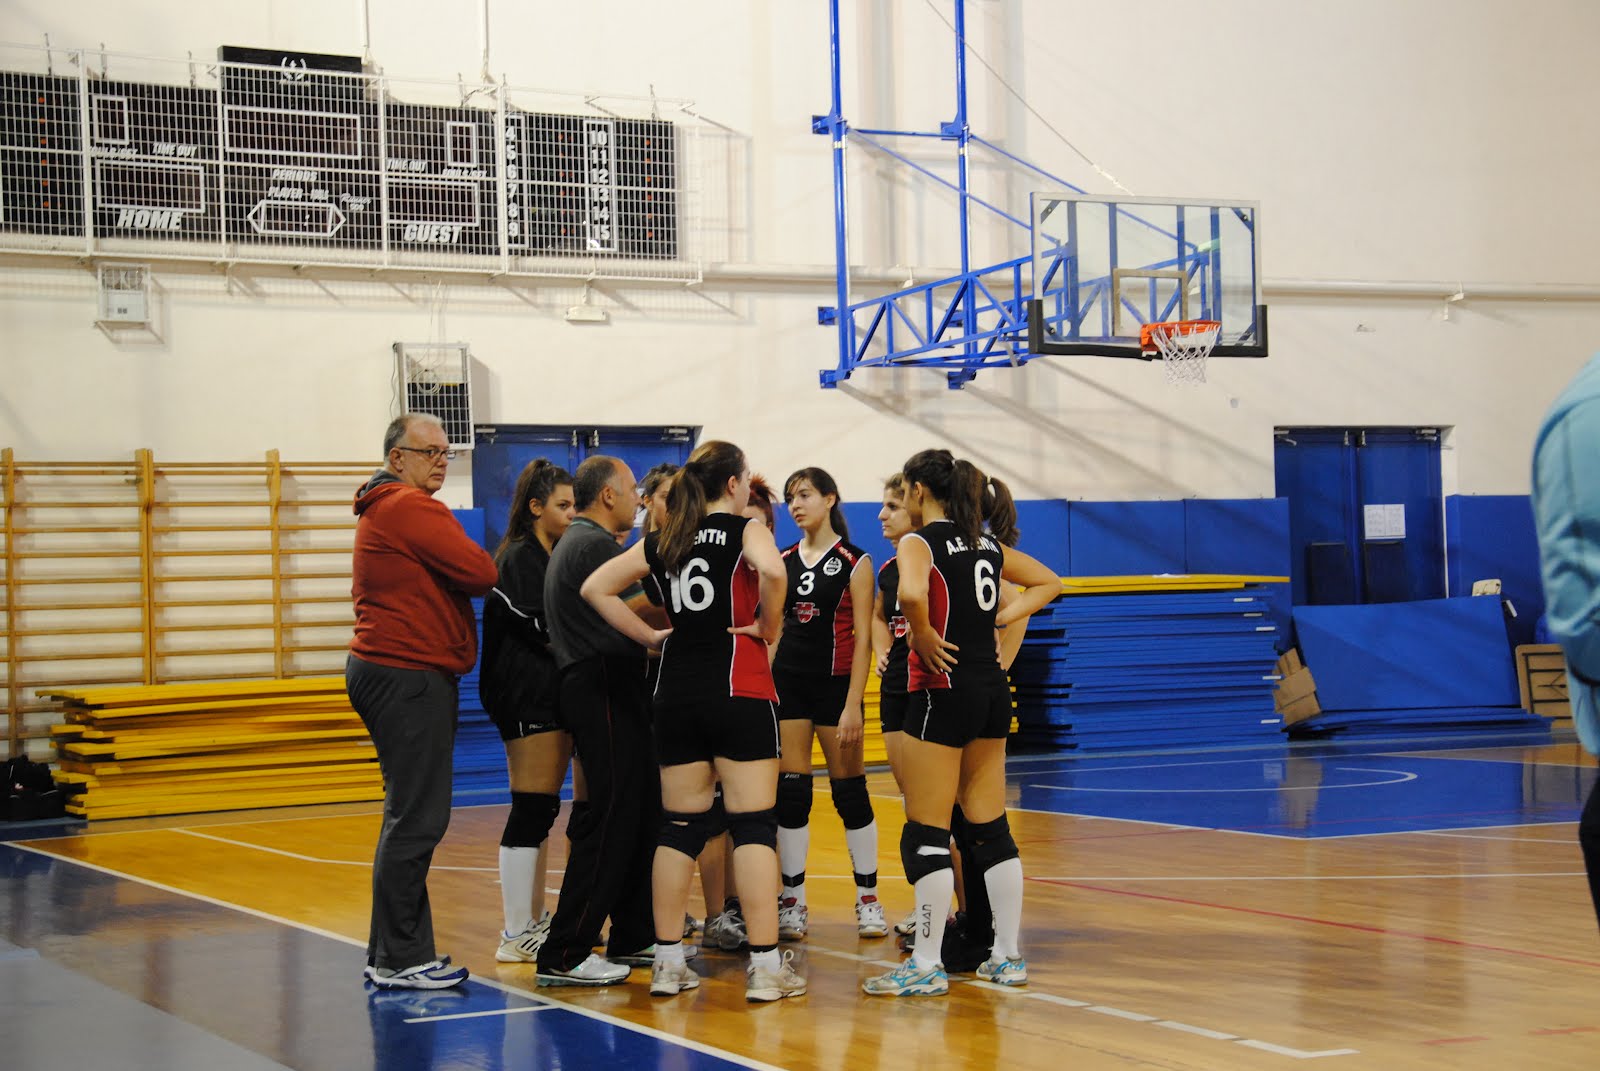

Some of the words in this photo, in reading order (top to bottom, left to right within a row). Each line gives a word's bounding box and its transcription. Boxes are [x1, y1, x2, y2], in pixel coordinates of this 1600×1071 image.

[506, 126, 516, 141] 4
[591, 130, 608, 146] 10
[152, 142, 176, 156] TIME
[177, 145, 198, 158] OUT
[507, 145, 516, 160] 5
[591, 149, 608, 165] 11
[273, 169, 318, 181] PERIODS
[507, 164, 517, 179] 6
[591, 168, 609, 184] 12
[267, 186, 304, 199] PLAYER
[508, 183, 518, 199] 7
[592, 187, 609, 202] 13
[508, 202, 518, 218] 8
[592, 206, 610, 221] 14
[117, 208, 184, 230] HOME
[403, 224, 463, 244] GUEST
[509, 222, 519, 237] 9
[593, 224, 611, 240] 15
[665, 557, 715, 613] 16
[796, 571, 816, 596] 3
[974, 559, 997, 612] 6
